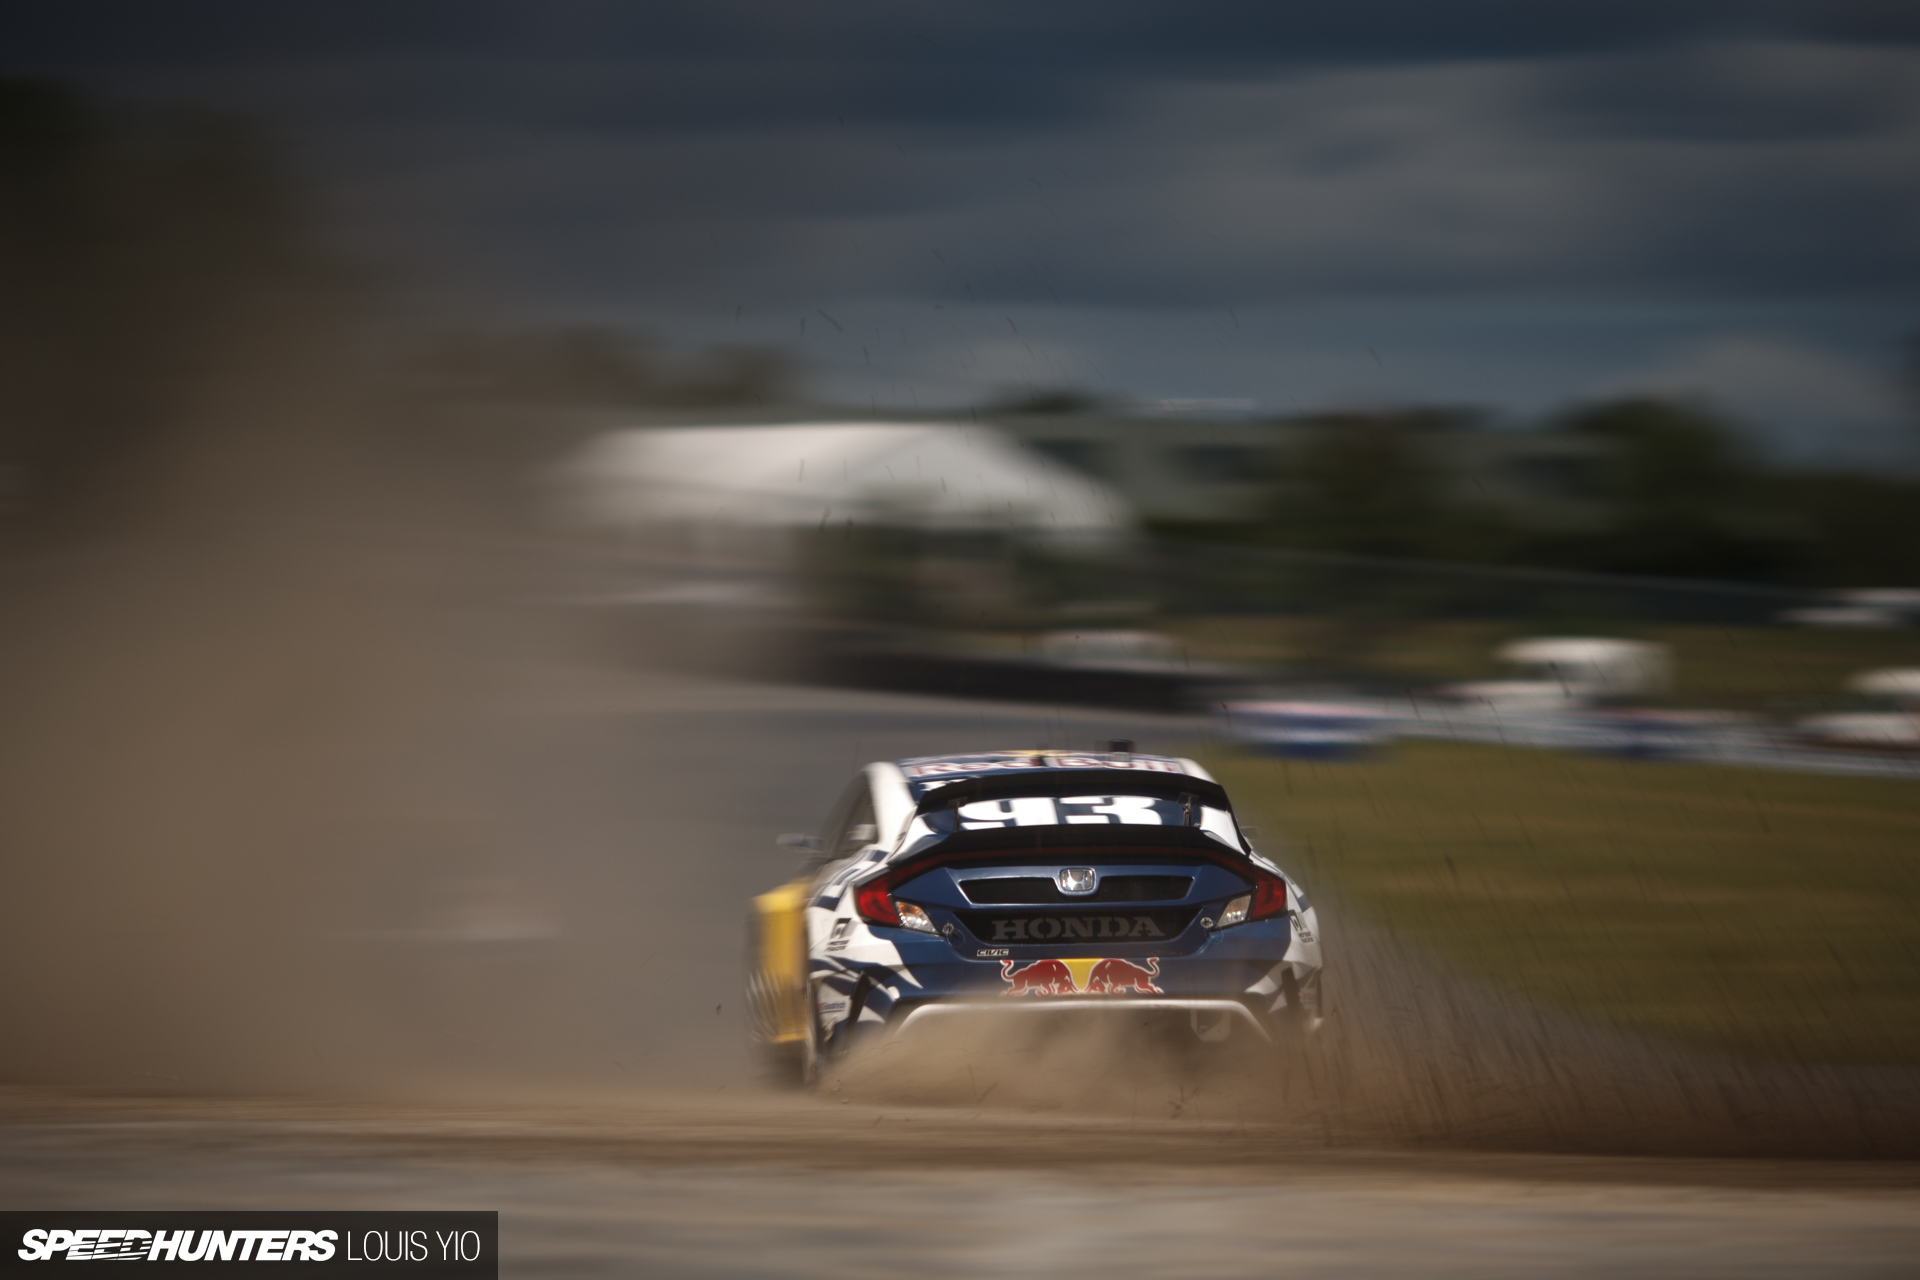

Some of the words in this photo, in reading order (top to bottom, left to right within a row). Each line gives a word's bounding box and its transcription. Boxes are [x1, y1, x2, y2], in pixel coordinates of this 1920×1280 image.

[909, 756, 1044, 777] Red
[957, 795, 1163, 829] 93
[991, 916, 1165, 940] HONDA
